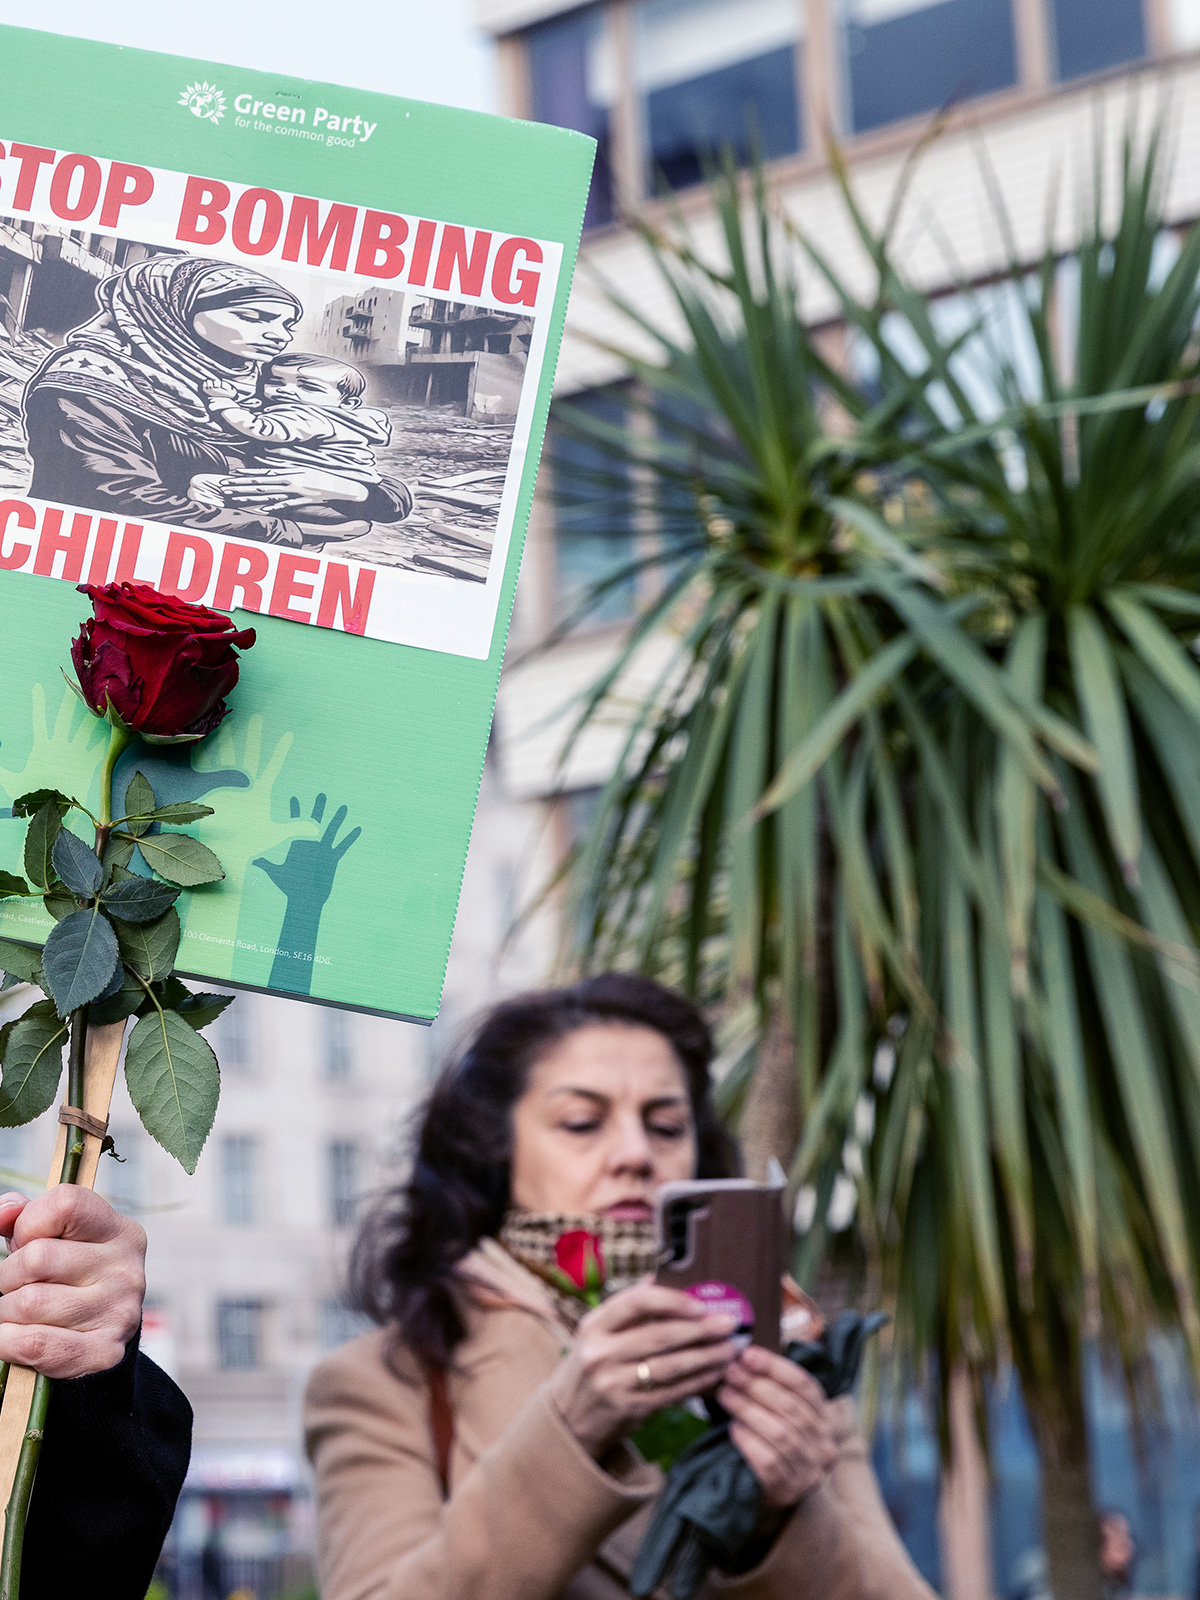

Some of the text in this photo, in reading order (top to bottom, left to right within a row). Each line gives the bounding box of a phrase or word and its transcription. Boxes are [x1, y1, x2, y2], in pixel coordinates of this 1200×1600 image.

[234, 93, 378, 142] Green Party
[234, 115, 356, 148] for the common good
[175, 175, 544, 307] BOMBING
[183, 929, 197, 939] 100
[198, 932, 235, 947] Clements
[236, 940, 258, 952] Road,
[260, 944, 291, 958] London,
[293, 951, 312, 962] SE16
